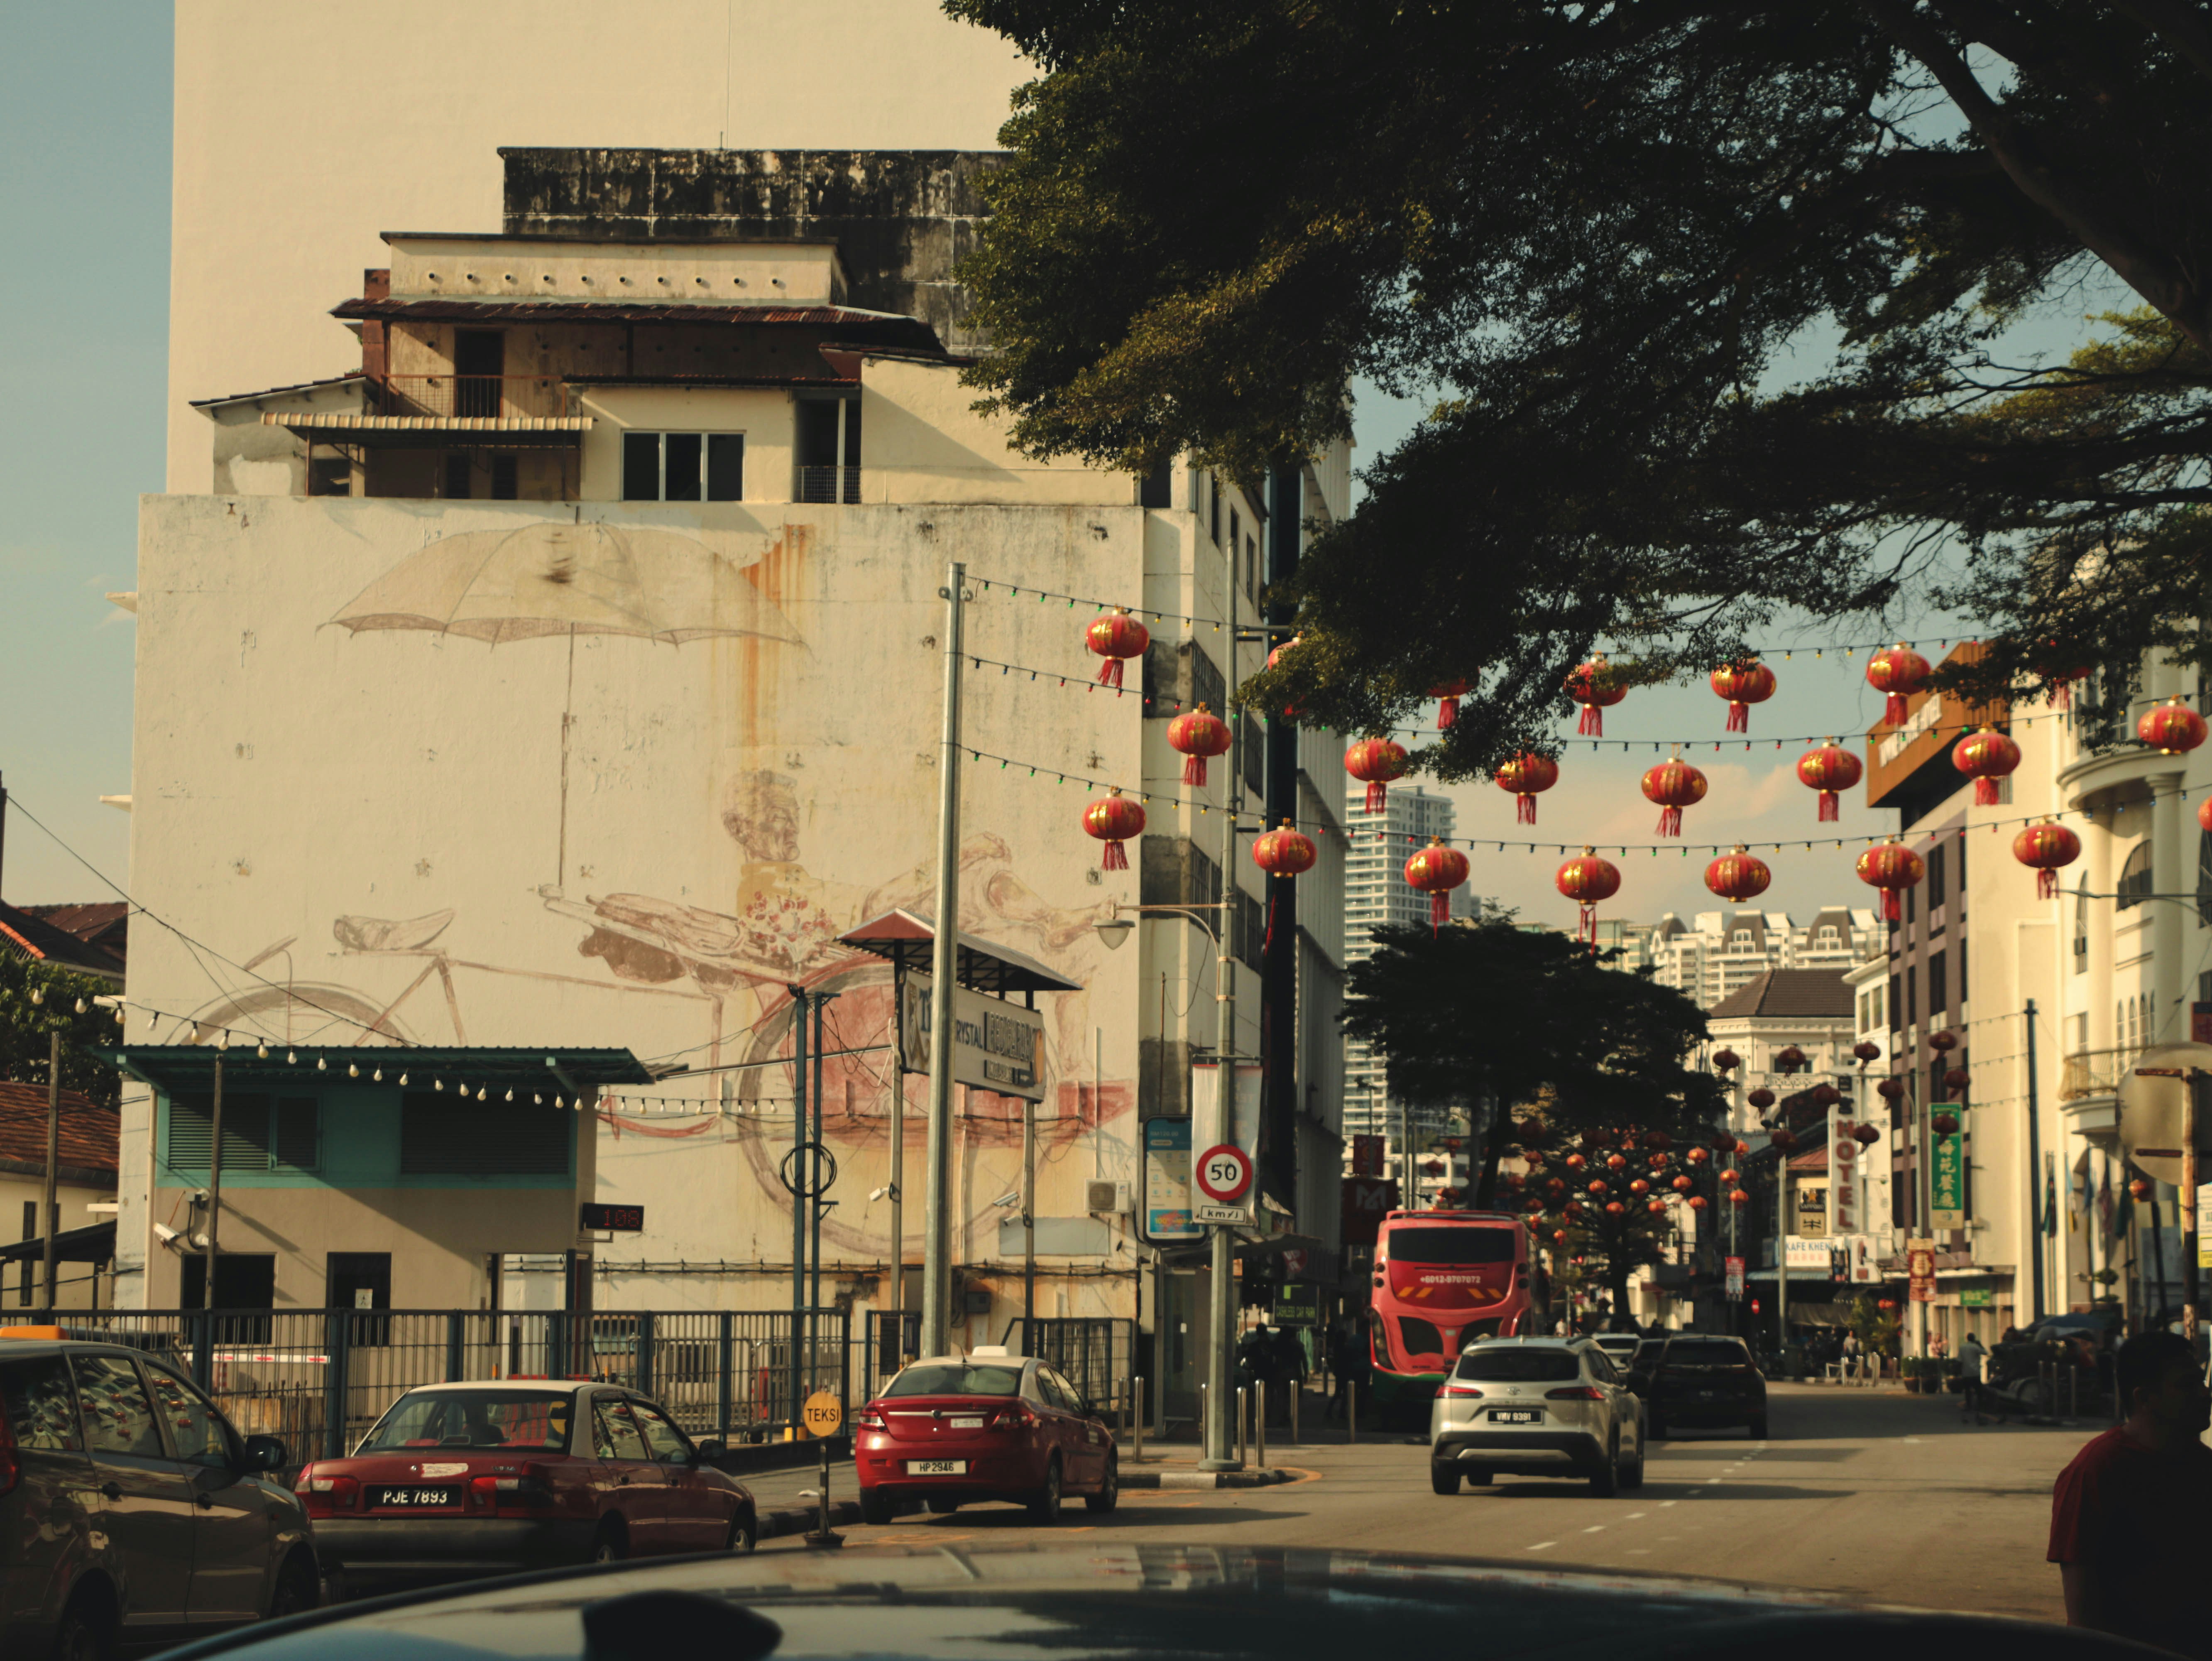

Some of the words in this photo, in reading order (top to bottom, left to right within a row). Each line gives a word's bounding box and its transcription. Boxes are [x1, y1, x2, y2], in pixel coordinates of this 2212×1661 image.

[956, 1019, 983, 1049] RYSTAL
[1211, 1164, 1237, 1181] 50
[1836, 1119, 1855, 1227] HOTEL
[604, 1209, 639, 1227] 108
[807, 1408, 839, 1422] TEKSI
[383, 1490, 409, 1504] PJE
[414, 1490, 448, 1504] 7893
